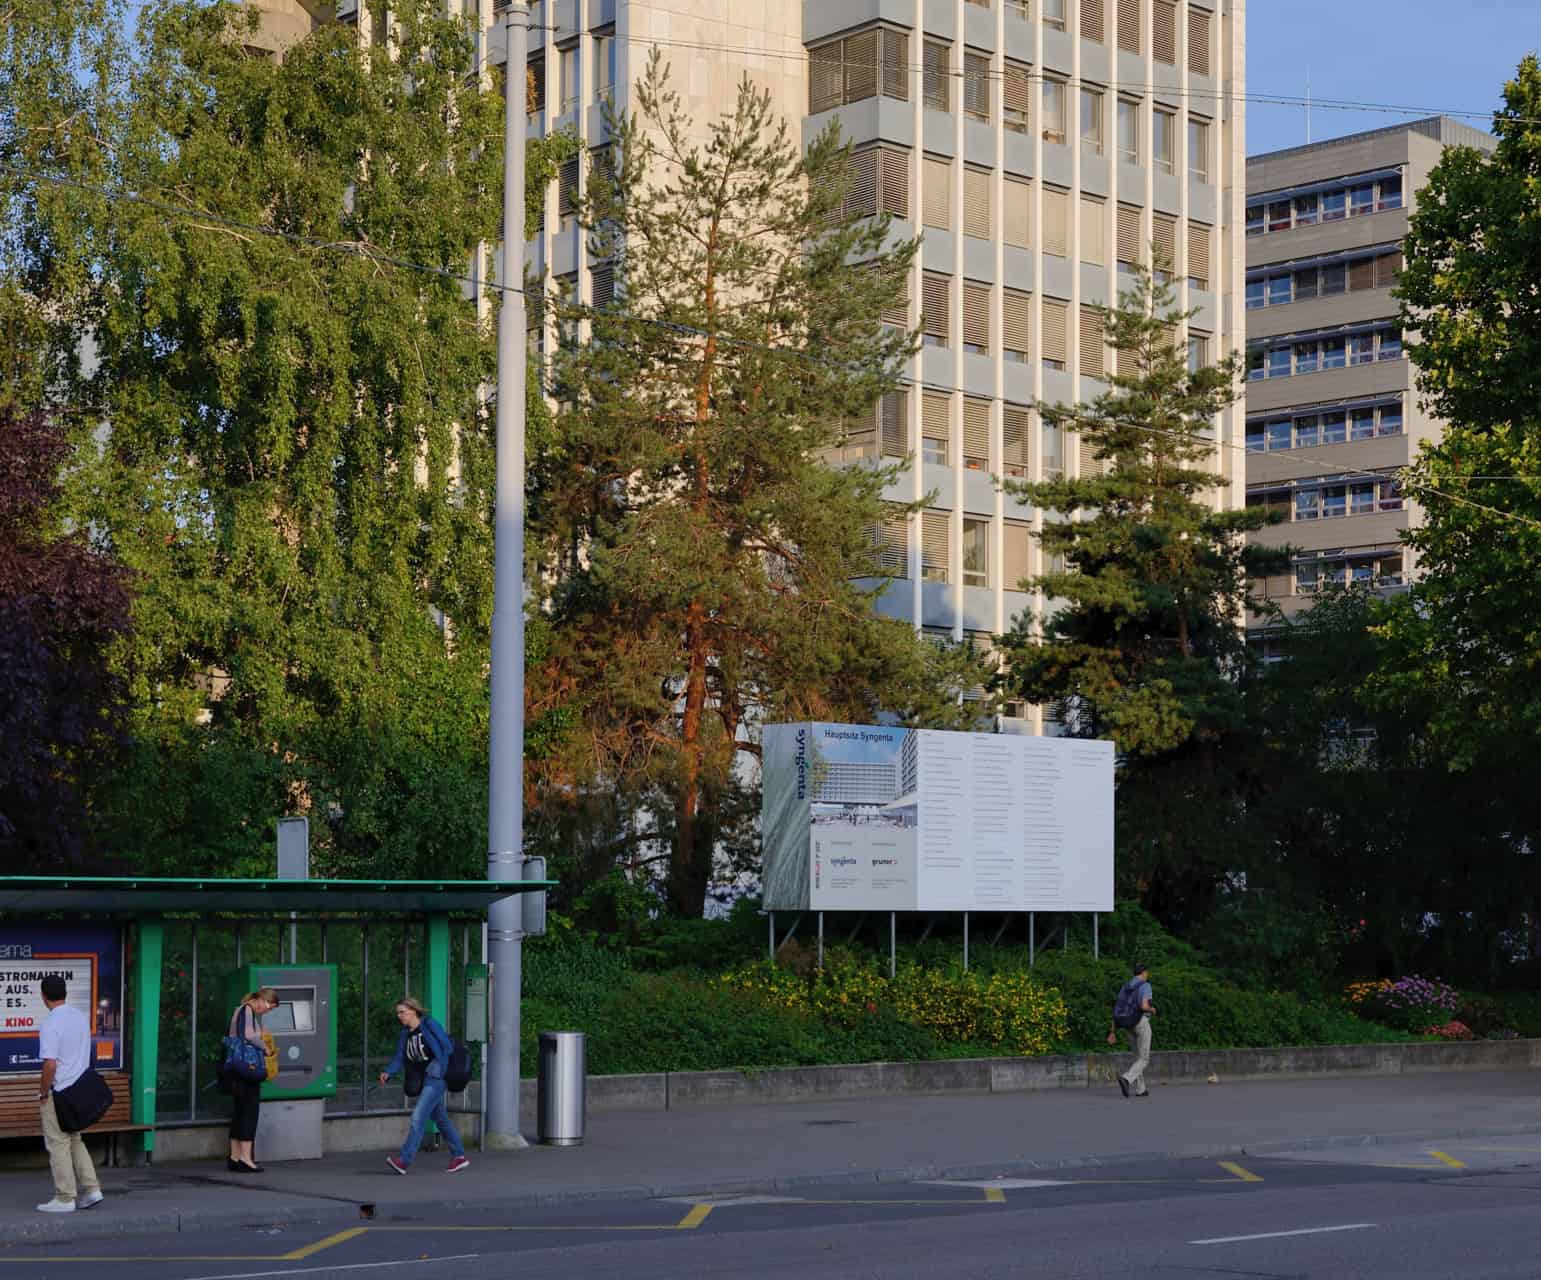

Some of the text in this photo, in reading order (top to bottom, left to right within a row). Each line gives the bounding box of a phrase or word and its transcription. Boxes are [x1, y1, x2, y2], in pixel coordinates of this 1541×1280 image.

[860, 731, 894, 742] Syngenta
[795, 728, 807, 800] syngenta
[5, 984, 33, 994] AUS.
[7, 998, 27, 1007] ES.
[5, 1017, 33, 1027] KINO
